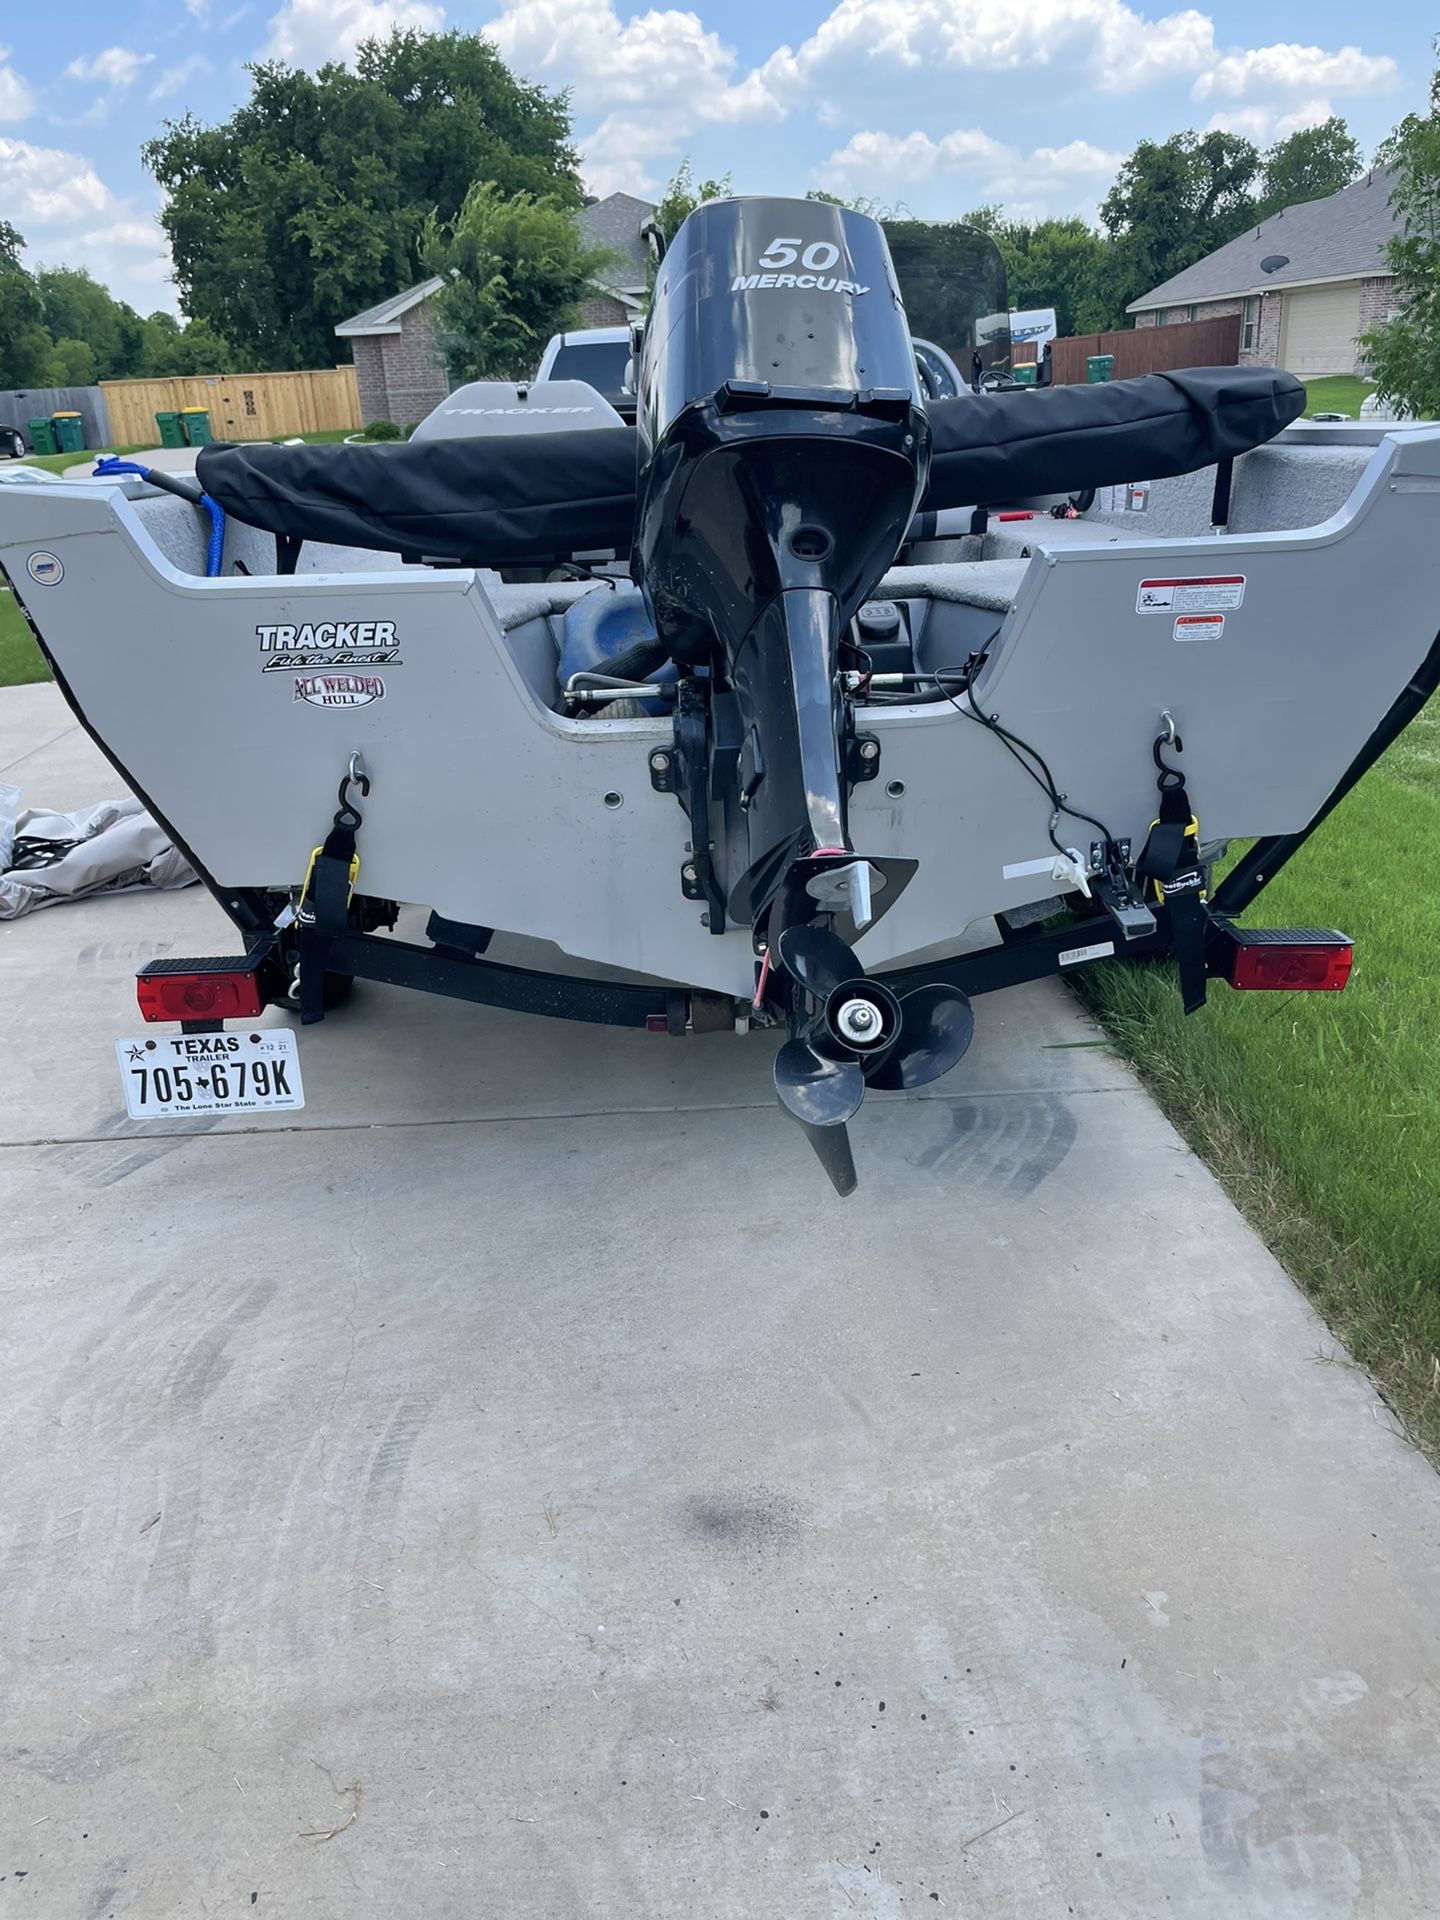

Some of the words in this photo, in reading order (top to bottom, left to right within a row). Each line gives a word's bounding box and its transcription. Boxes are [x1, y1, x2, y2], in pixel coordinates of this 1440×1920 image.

[758, 238, 840, 271] 50
[731, 274, 871, 297] MERCURY
[443, 406, 595, 415] TRACKER
[256, 621, 397, 651] TRACKER
[267, 653, 303, 667] Fish
[304, 654, 331, 665] the
[294, 676, 322, 699] ALL
[320, 676, 385, 698] WELDED
[322, 694, 359, 705] HULL
[170, 1037, 240, 1056] TEXAS
[185, 1054, 230, 1063] TRAILER
[131, 1065, 193, 1105] 705
[210, 1060, 291, 1099] 679K
